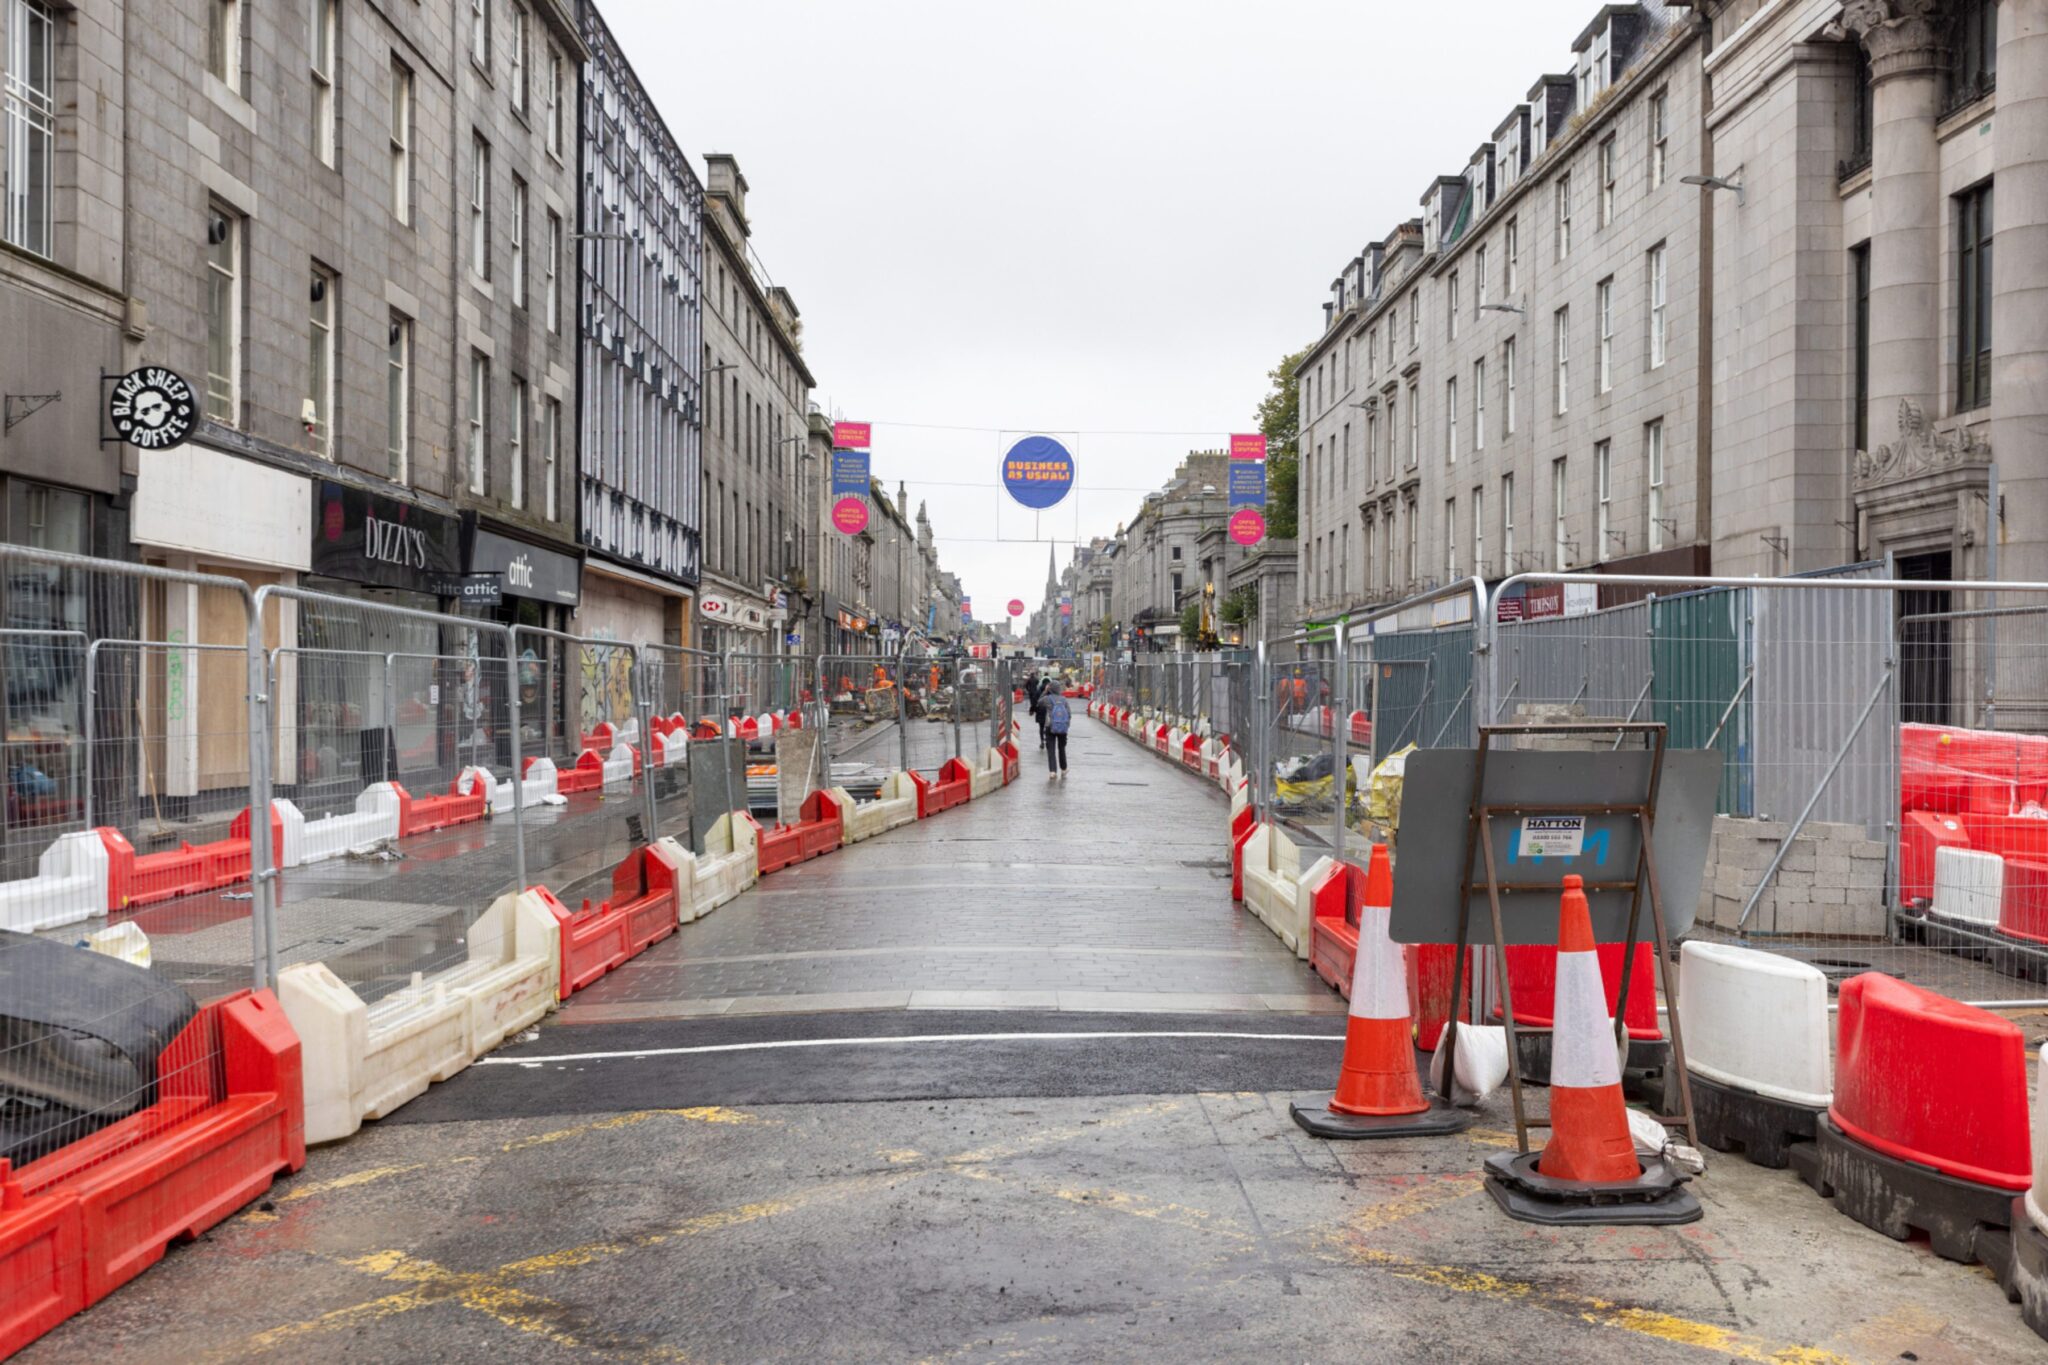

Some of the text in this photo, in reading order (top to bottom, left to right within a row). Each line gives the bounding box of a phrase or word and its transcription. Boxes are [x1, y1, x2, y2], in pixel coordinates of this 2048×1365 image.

[112, 368, 189, 416] BLACK SHEEP
[130, 415, 189, 447] COFFEE
[1008, 461, 1068, 470] BUSINESS
[1008, 471, 1023, 480] AS
[366, 516, 426, 570] DIZZY'S
[509, 554, 533, 589] attic
[464, 581, 498, 595] attic
[1530, 595, 1559, 613] TIMPSON
[1527, 820, 1581, 828] HATTON
